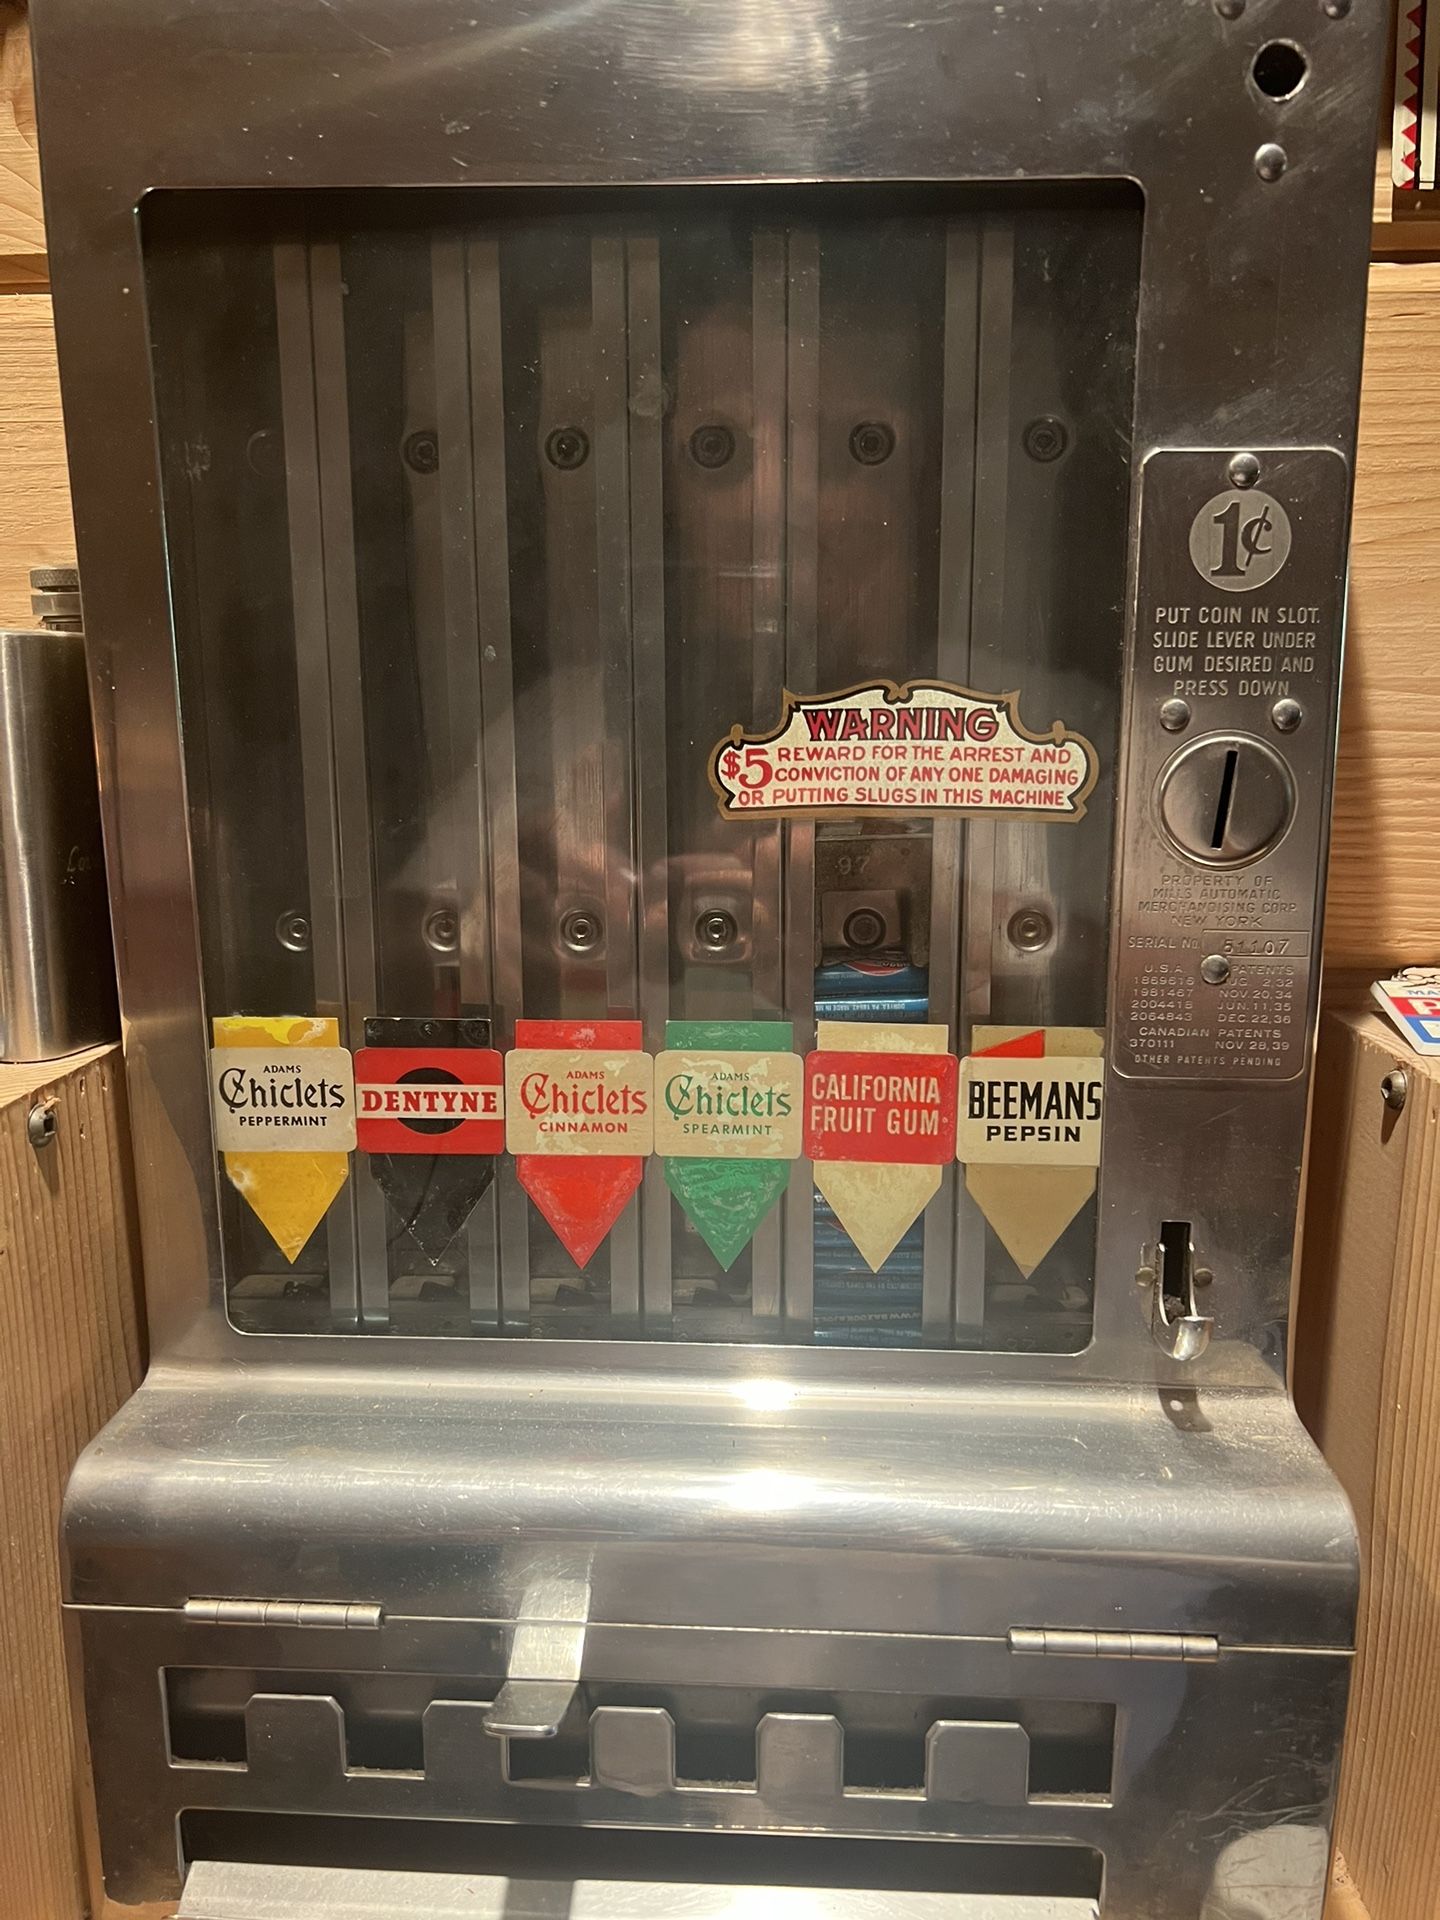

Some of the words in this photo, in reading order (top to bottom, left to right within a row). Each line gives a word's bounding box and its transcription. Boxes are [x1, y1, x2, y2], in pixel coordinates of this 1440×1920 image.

[1211, 501, 1272, 576] 1¢
[1155, 607, 1191, 624] PUT
[1198, 607, 1241, 624] COIN
[1251, 607, 1269, 624] IN
[1153, 632, 1199, 648] SLIDE
[1207, 632, 1255, 648] LEVER
[1263, 632, 1316, 648] UNDER
[1154, 656, 1193, 672] GUM
[1204, 656, 1272, 672] DESIRED
[1281, 656, 1314, 672] AND
[1174, 680, 1229, 696] PRESS
[1238, 680, 1290, 696] DOWN
[805, 708, 1000, 741] WARNING
[721, 749, 773, 789] $5
[778, 747, 865, 761] REWARD
[872, 746, 909, 760] FOR
[912, 746, 943, 761] THE
[950, 747, 1026, 763] ARREST
[1031, 748, 1071, 764] AND
[774, 767, 880, 782] CONVICTION
[886, 766, 909, 781] OF
[910, 767, 944, 782] ANY
[948, 767, 984, 783] ONE
[989, 768, 1078, 785] DAMAGING
[738, 790, 764, 805] OR
[773, 788, 849, 804] PUTTING
[855, 788, 917, 803] SLUGS
[921, 789, 937, 803] IN
[944, 789, 984, 804] THIS
[989, 790, 1064, 805] MACHINE
[1162, 875, 1244, 887] PROPERTY
[1255, 876, 1273, 887] OF
[1152, 888, 1192, 899] MILLS
[1201, 888, 1281, 900] AUTOMATIC
[1138, 901, 1256, 913] MERCHANDISING
[1171, 915, 1207, 927] NEW
[1215, 916, 1263, 928] YORK
[1128, 936, 1177, 949] SERIAL
[1223, 939, 1291, 955] 51107
[1231, 965, 1295, 976] PATENTS
[1139, 1027, 1209, 1037] CANADIAN
[1218, 1029, 1281, 1038] PATENTS
[1135, 1054, 1170, 1064] OTHER
[1177, 1055, 1225, 1065] PATENTS
[1233, 1056, 1281, 1066] PENDING
[263, 1065, 302, 1075] ADAMS
[566, 1070, 606, 1080] ADAMS
[711, 1072, 750, 1082] ADAMS
[218, 1067, 346, 1115] Chiclets
[519, 1073, 648, 1120] Chiclets
[665, 1074, 792, 1120] Chiclets
[811, 1073, 941, 1105] CALIFORNIA
[361, 1091, 498, 1114] DENTYNE
[968, 1080, 1102, 1121] BEEMANS
[239, 1116, 328, 1128] PEPPERMINT
[539, 1121, 628, 1134] CINNAMON
[811, 1105, 877, 1134] FRUIT
[887, 1107, 939, 1136] GUM
[683, 1123, 773, 1136] SPEARMINT
[986, 1126, 1081, 1143] PEPSIN
